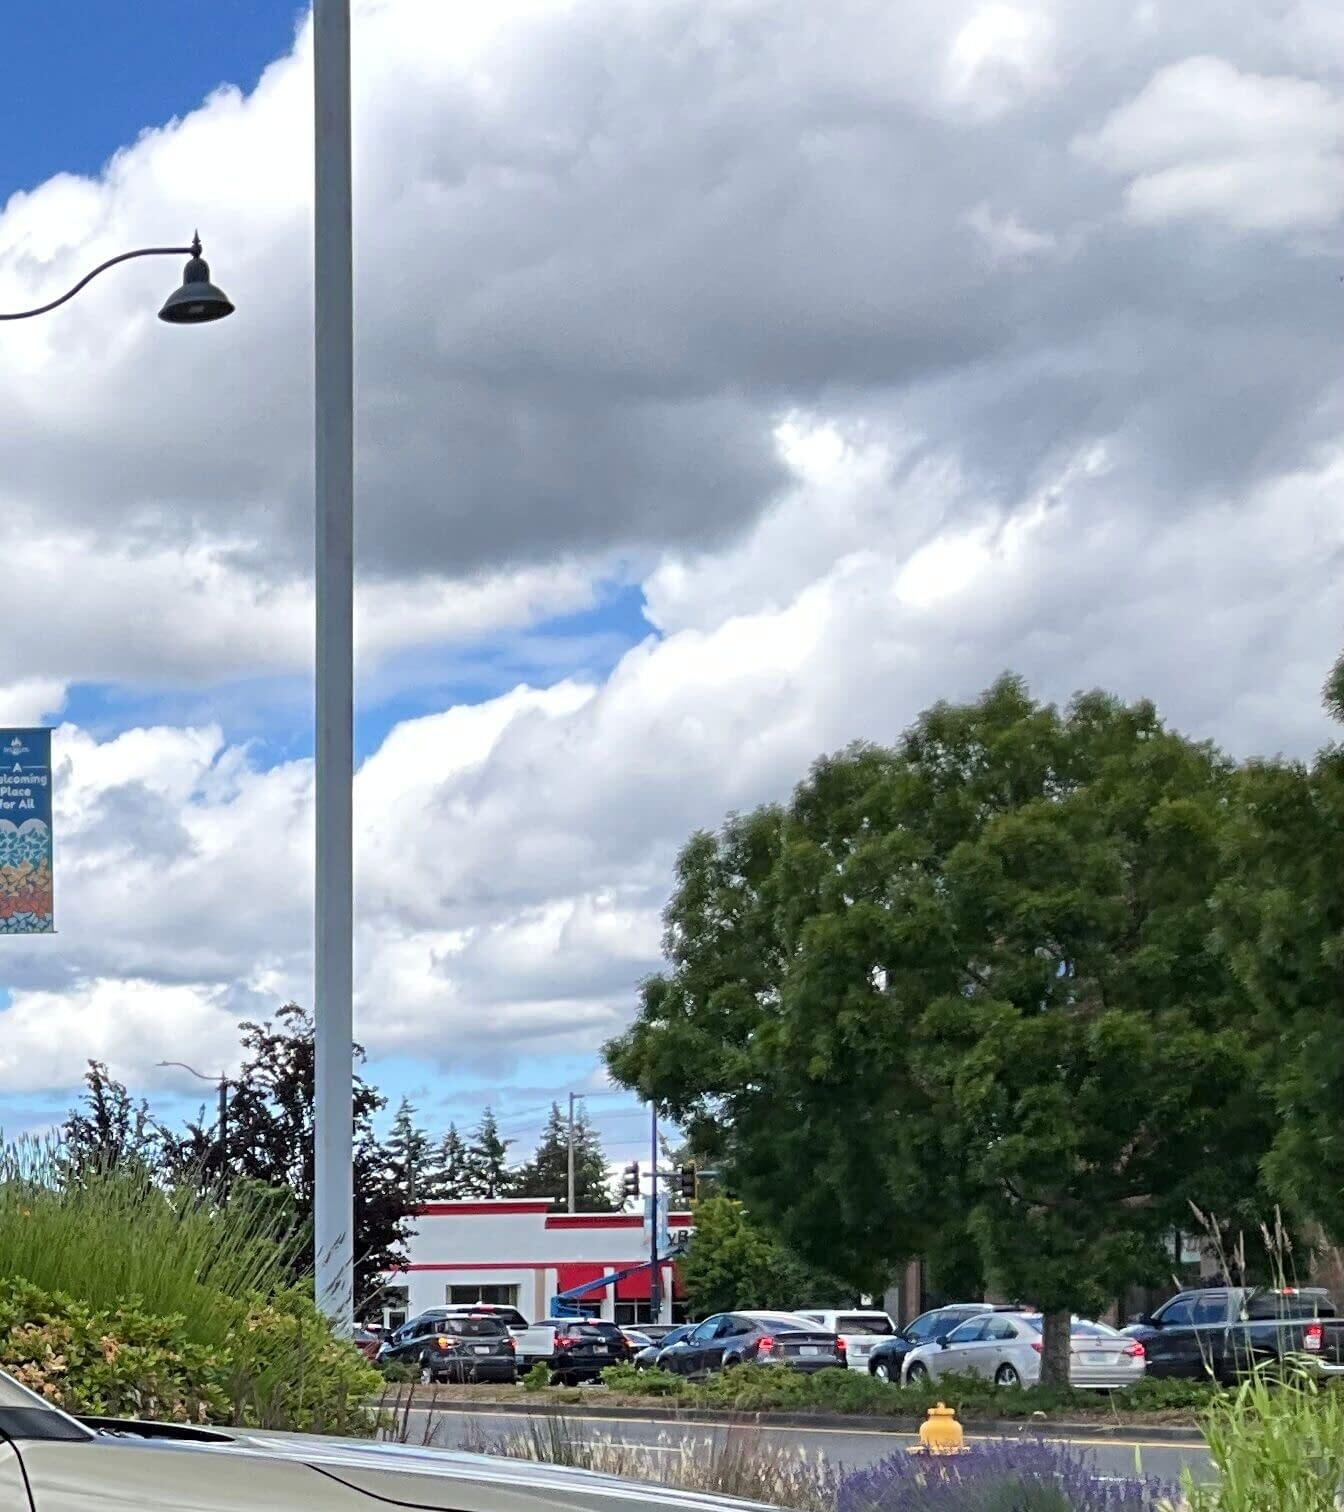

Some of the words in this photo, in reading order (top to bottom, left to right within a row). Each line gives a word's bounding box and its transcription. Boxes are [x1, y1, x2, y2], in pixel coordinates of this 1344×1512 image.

[12, 762, 23, 773] A
[0, 786, 32, 797] Place
[18, 798, 35, 809] All
